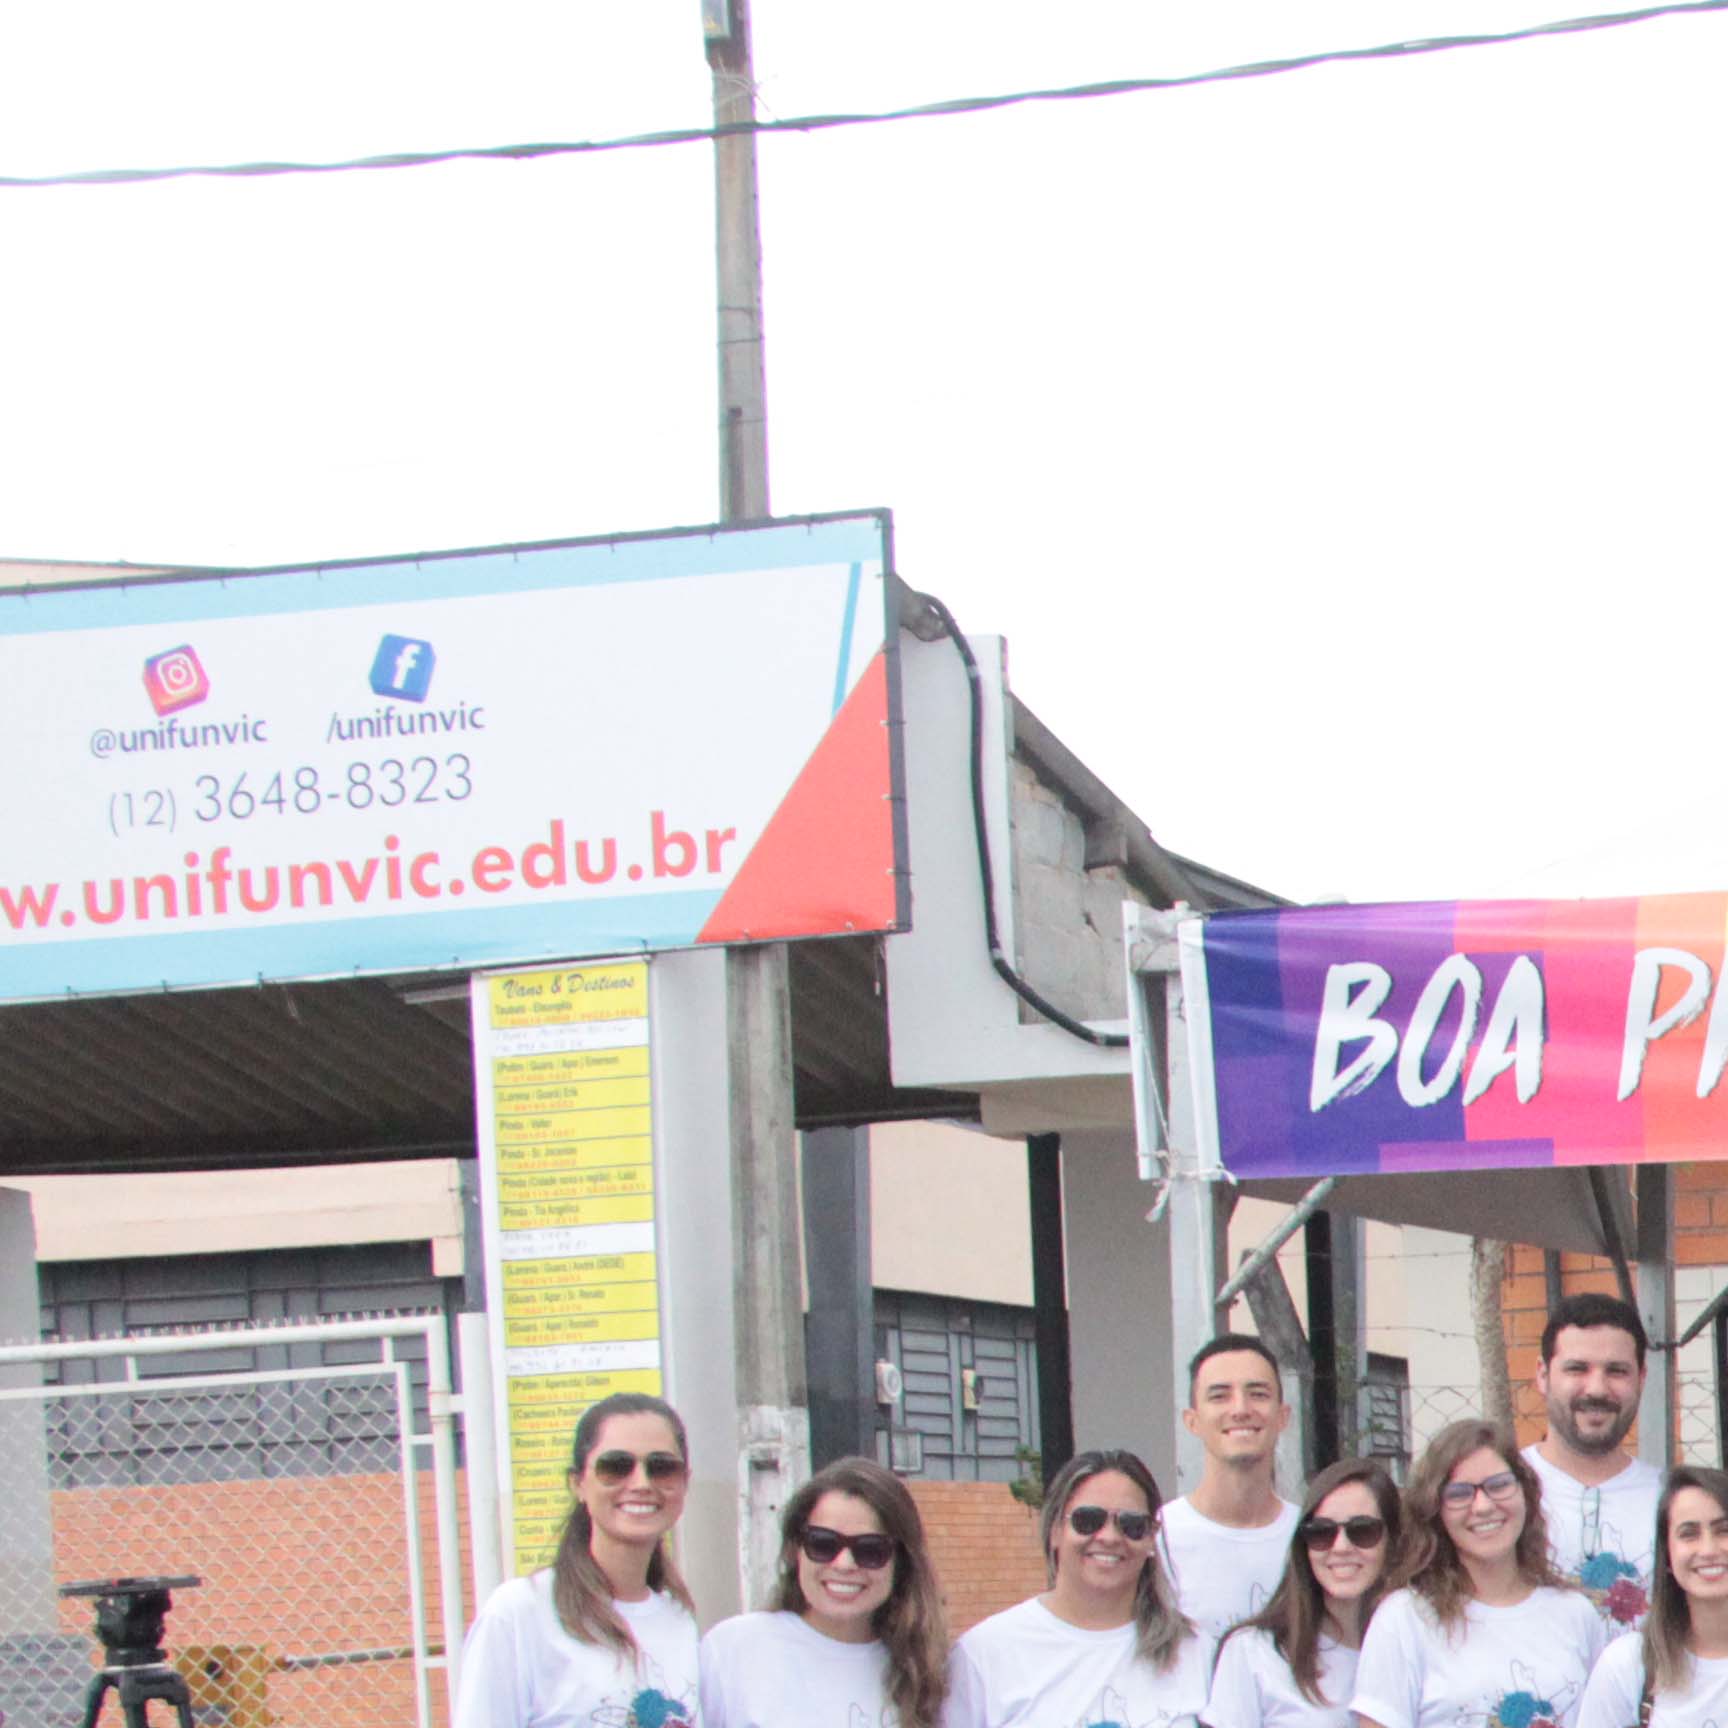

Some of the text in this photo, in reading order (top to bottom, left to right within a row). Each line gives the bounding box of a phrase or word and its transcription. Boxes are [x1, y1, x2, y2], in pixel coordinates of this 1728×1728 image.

[90, 700, 487, 759] @unifunvic /unifunvic
[109, 753, 473, 836] (12) 3648-8323
[503, 979, 543, 998] Vans
[567, 973, 635, 993] Destinos
[1311, 952, 1544, 1112] BOA
